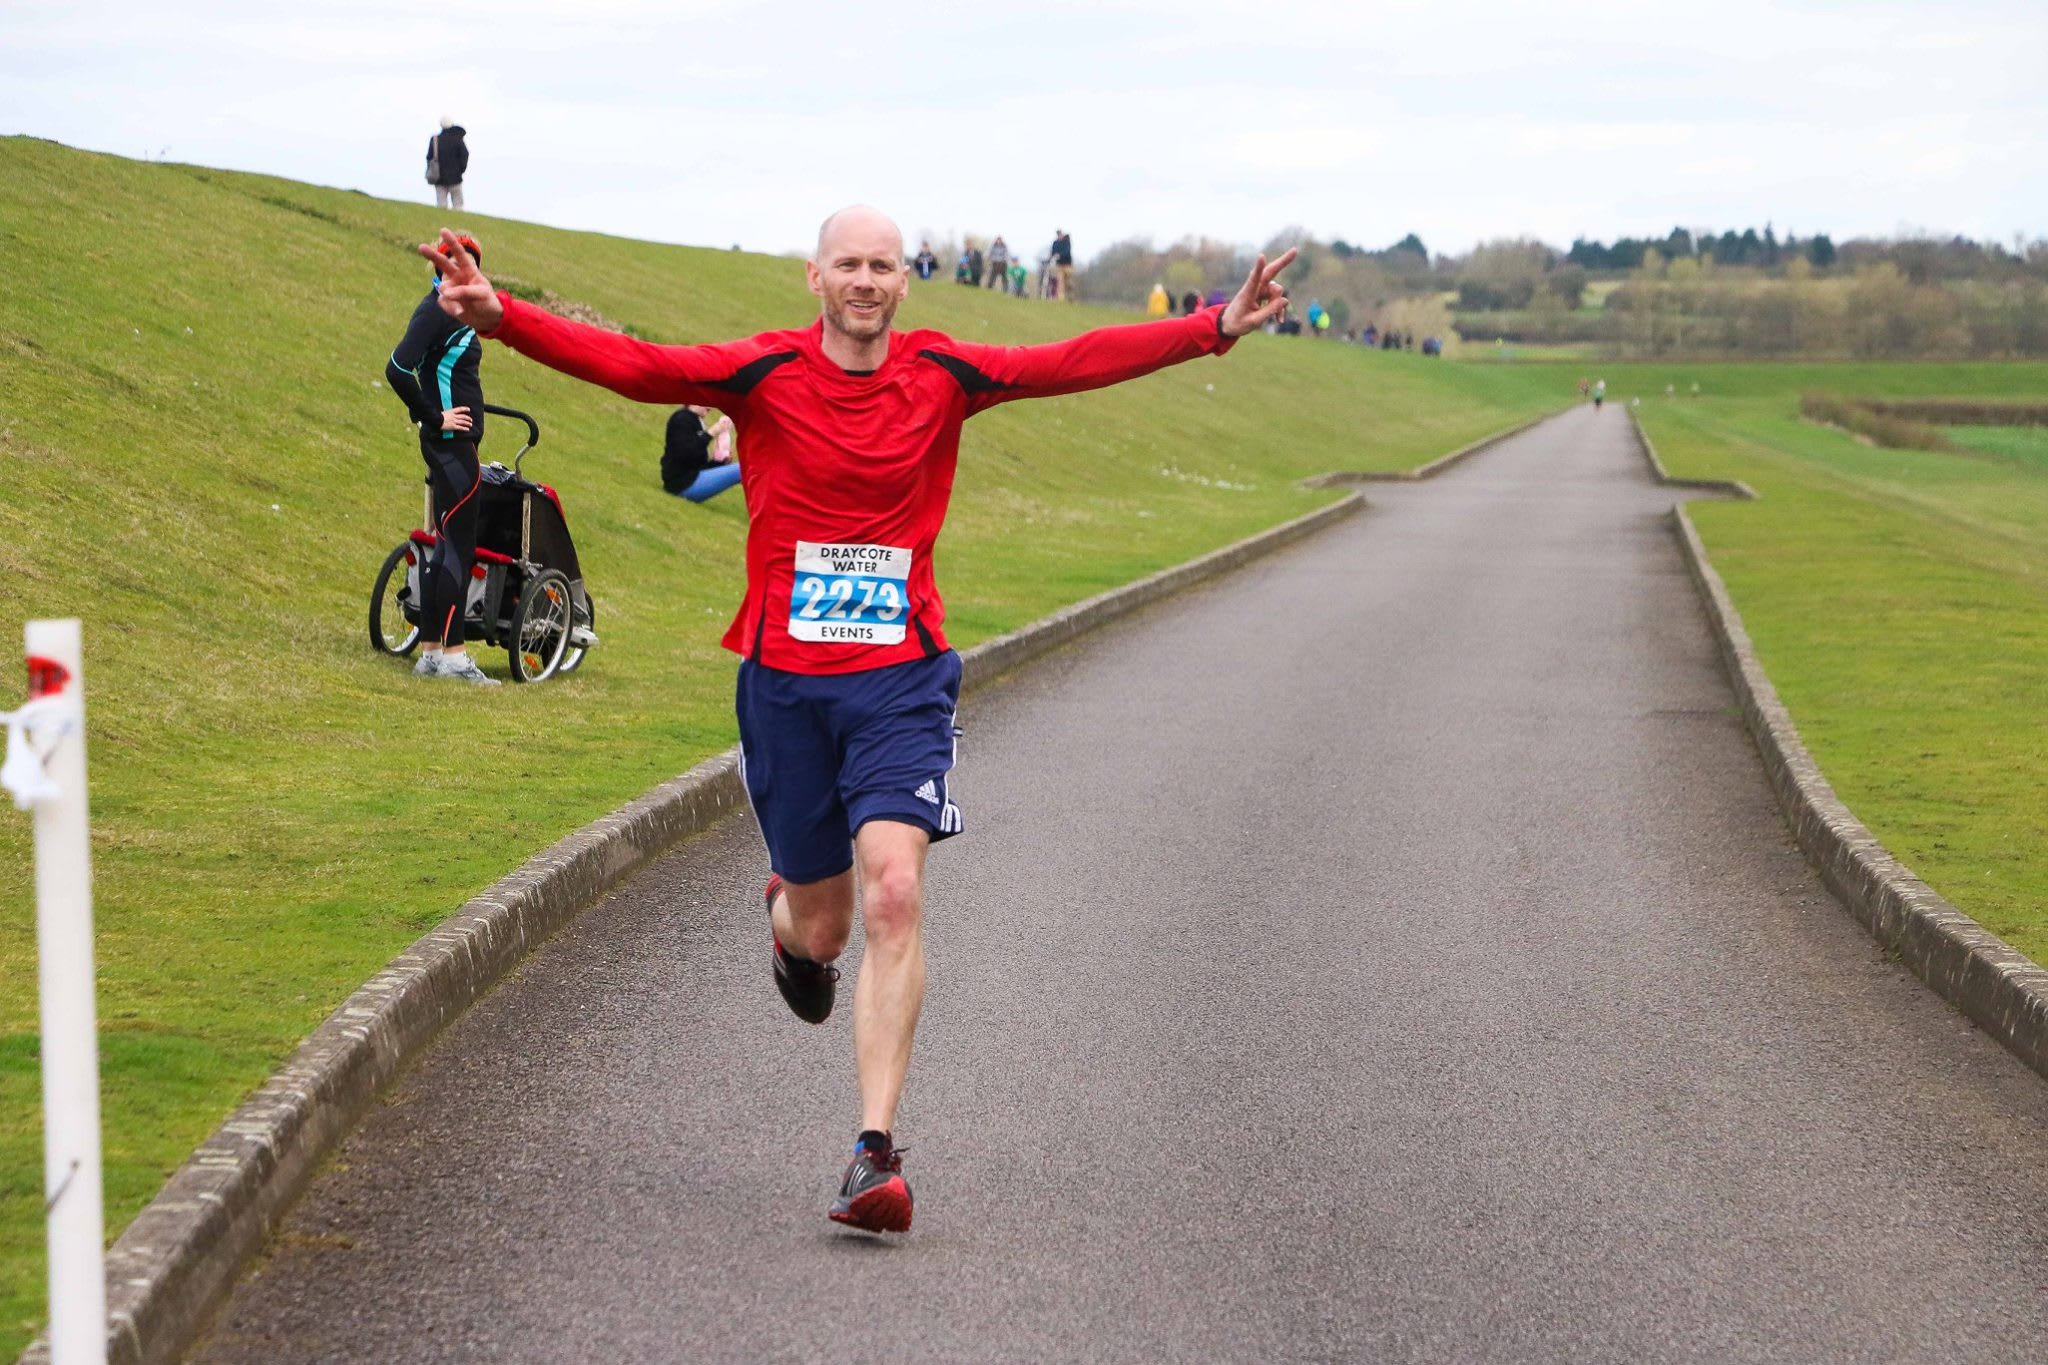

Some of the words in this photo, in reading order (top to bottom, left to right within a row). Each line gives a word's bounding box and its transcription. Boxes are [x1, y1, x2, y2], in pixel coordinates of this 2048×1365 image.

[821, 547, 892, 561] DRAYCOTE
[833, 561, 877, 573] WATER
[799, 577, 902, 621] 2273
[821, 626, 873, 639] EVENTS
